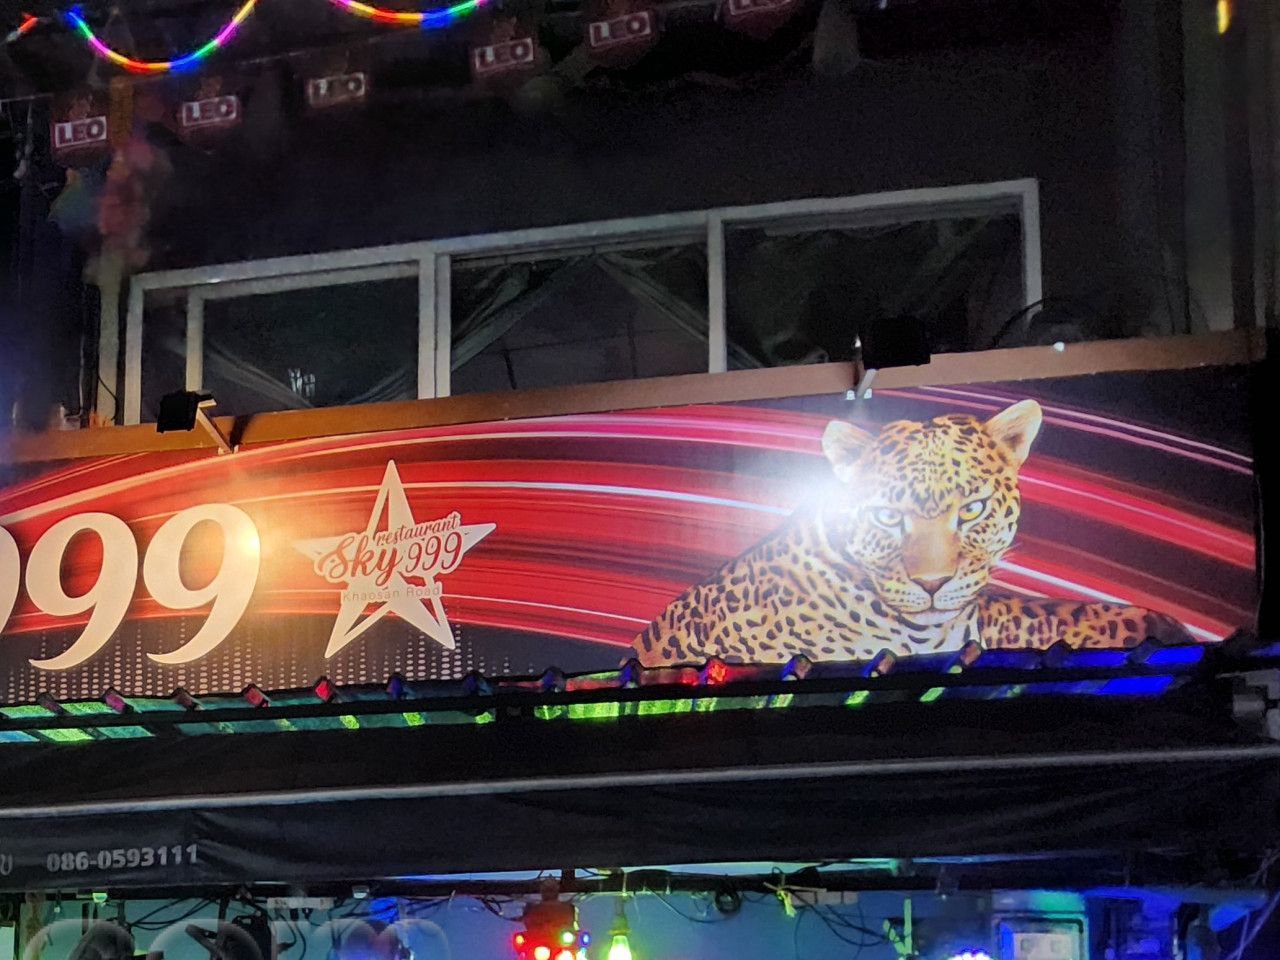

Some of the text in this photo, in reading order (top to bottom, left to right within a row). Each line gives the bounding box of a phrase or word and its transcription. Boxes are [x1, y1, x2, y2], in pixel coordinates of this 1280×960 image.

[59, 120, 104, 144] LEO
[375, 512, 459, 546] restaurant
[318, 531, 462, 587] Sky 999
[343, 584, 441, 601] Khaosan Road
[46, 844, 199, 873] 086-0593111
